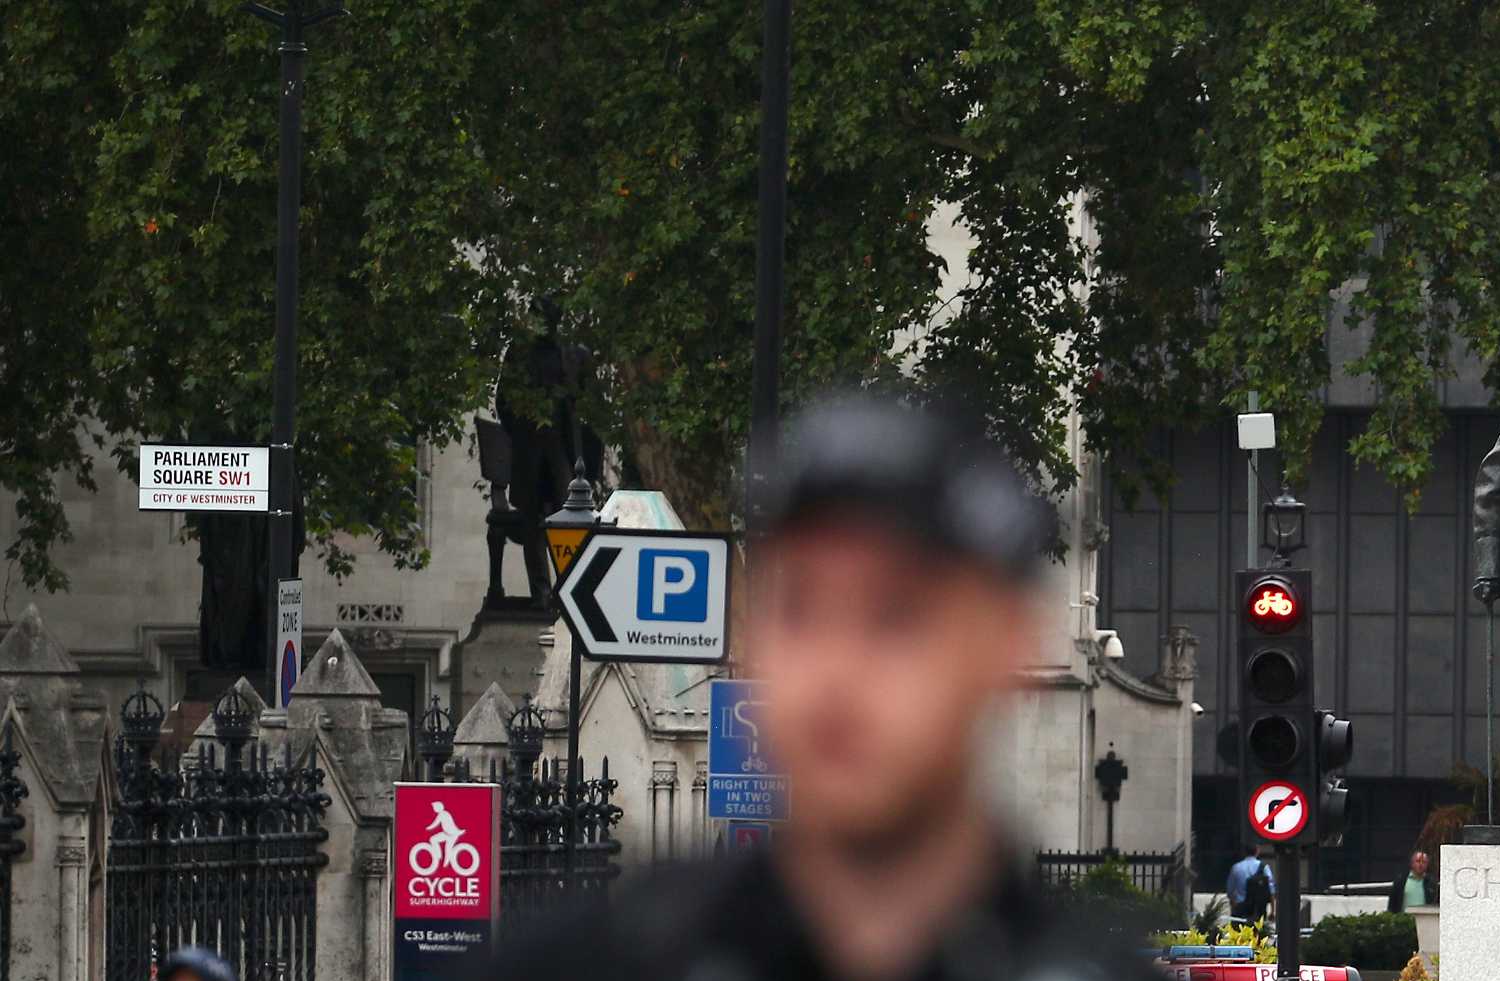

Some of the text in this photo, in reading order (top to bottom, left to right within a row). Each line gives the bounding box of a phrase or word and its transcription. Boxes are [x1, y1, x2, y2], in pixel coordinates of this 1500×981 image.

[154, 451, 250, 467] PARLIAMENT
[153, 469, 250, 486] SQUARE SW1
[153, 493, 255, 504] CITY OF WESTMINSTER
[553, 544, 578, 558] TA
[652, 556, 696, 614] P
[282, 611, 297, 633] ZONE
[627, 631, 718, 647] Westminster
[712, 779, 750, 790] RIGHT
[727, 791, 771, 802] IN TWO
[725, 803, 772, 815] STAGES
[409, 878, 479, 896] CYCLE
[409, 897, 480, 906] SUPERHIGHWAY
[404, 930, 482, 943] CS3 East-West
[418, 943, 467, 952] Westminster
